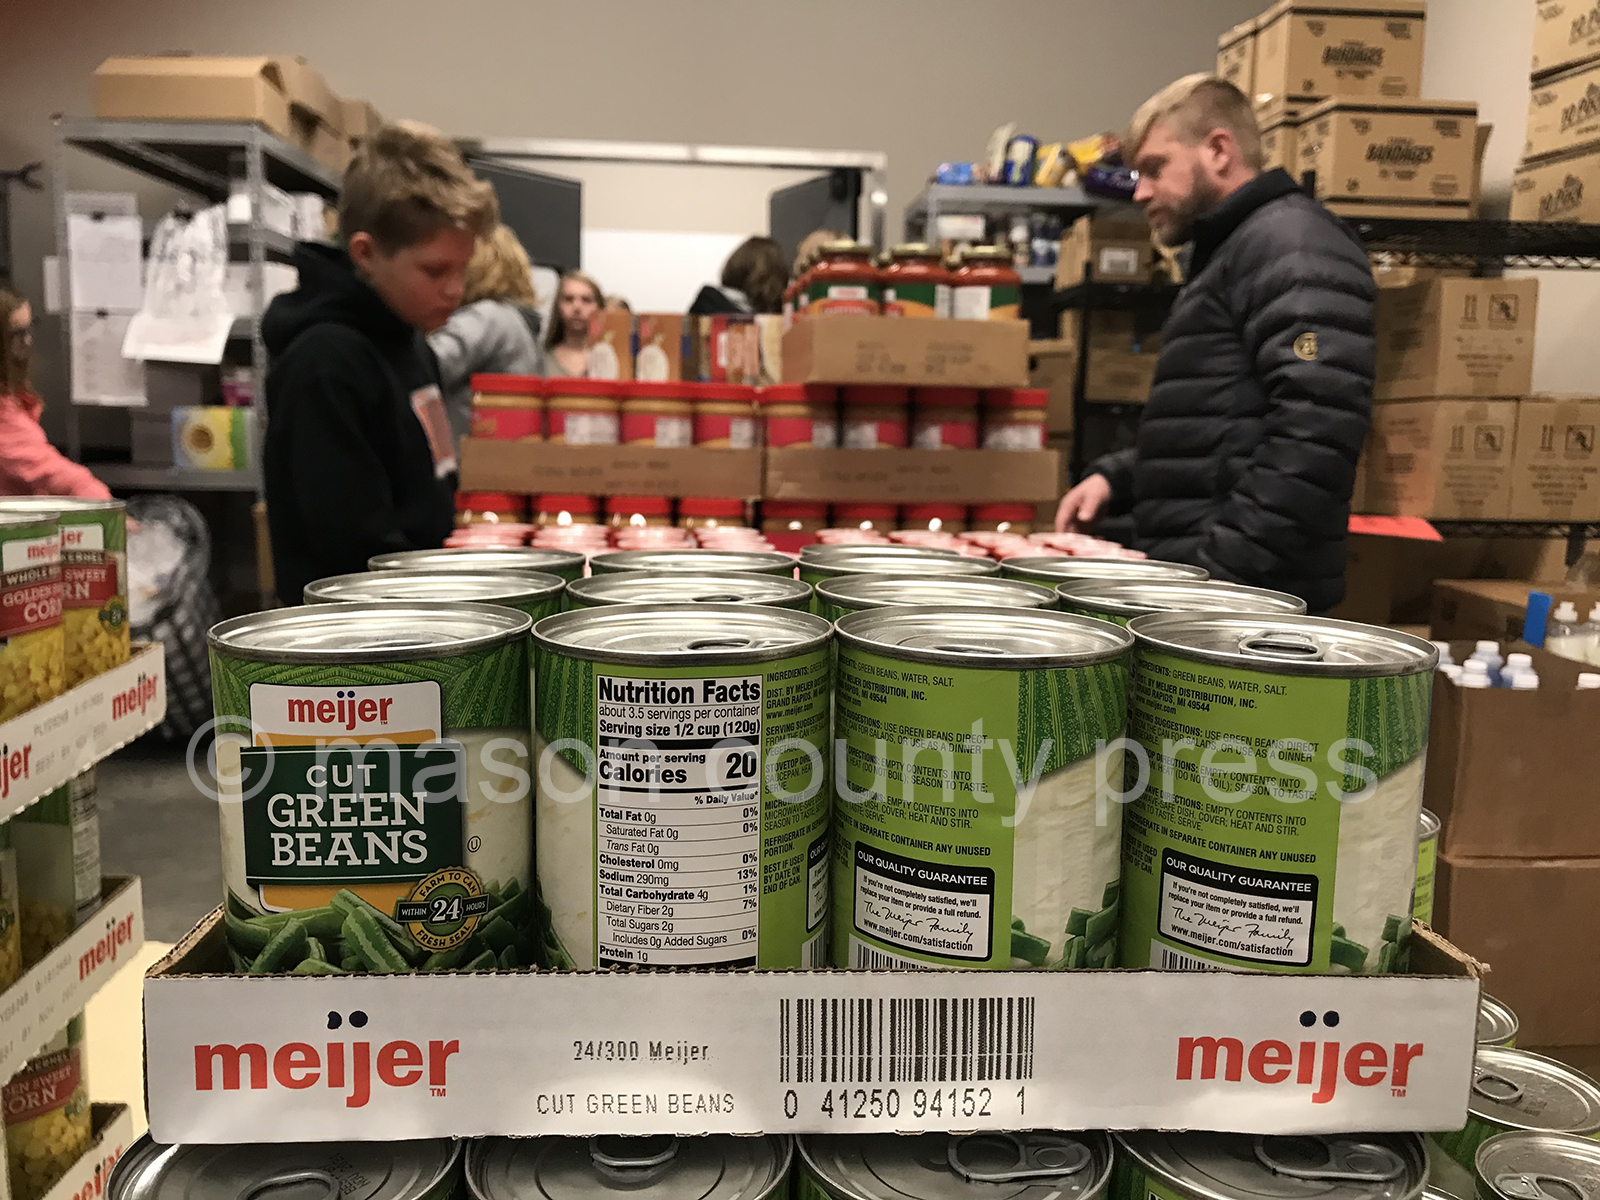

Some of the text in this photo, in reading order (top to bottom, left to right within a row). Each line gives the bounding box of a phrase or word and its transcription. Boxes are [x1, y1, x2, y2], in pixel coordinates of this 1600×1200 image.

[7, 567, 48, 585] WHOLE
[876, 667, 954, 687] BEANS, WATER, SALT.
[1173, 670, 1288, 696] GREEN BEANS, WATER, SALT.
[112, 672, 158, 720] meijer
[600, 678, 760, 704] Nutrition Facts
[863, 680, 927, 700] DISTRIBUTION, INC.
[1179, 687, 1257, 709] DISTRIBUTION, INC.
[288, 690, 392, 730] meijer
[599, 705, 760, 722] about 3.5 servings per container
[599, 719, 760, 737] Serving size 1/2 cup (120g)
[599, 750, 706, 764] Amount per serving
[599, 751, 756, 783] Calories 20
[0, 742, 32, 798] jer
[306, 764, 377, 788] CUT
[267, 791, 427, 827] GREEN
[695, 796, 703, 805] %
[706, 794, 729, 805] Daily
[599, 807, 758, 824] Total Fat 0g 0%
[606, 822, 758, 840] Saturated Fat 0g 0%
[860, 823, 991, 856] SEPARATE CONTAINER ANY UNUSED
[270, 830, 428, 866] BEANS
[606, 840, 659, 855] Trans Fat 0g
[1170, 827, 1316, 863] SEPARATE CONTAINER ANY UNUSED
[599, 852, 758, 872] Cholesterol 0mg 0%
[858, 850, 987, 885] OUR QUALITY GUARANTEE
[419, 872, 477, 897] FARM TO CAN
[599, 868, 757, 886] Sodium 290mg 13%
[1166, 857, 1312, 892] OUR QUALITY GUARANTEE
[599, 883, 757, 902] Total Carbohydrate 4g 1%
[860, 885, 877, 900] replace
[878, 892, 890, 903] your
[891, 896, 904, 908] item
[913, 902, 937, 915] provide
[944, 908, 955, 916] full
[957, 910, 981, 919] refund.
[868, 876, 883, 889] you're
[884, 882, 893, 892] not
[894, 885, 926, 902] completely
[928, 894, 958, 906] satisfied,
[960, 898, 976, 906] we'll
[1172, 881, 1299, 913] If you're not completely satisfied, we'll
[401, 908, 427, 916] WITHIN
[432, 898, 460, 921] 24
[466, 901, 486, 911] HOURS
[606, 898, 757, 917] Dietary Fiber 2g 7%
[1169, 892, 1189, 906] replace
[1190, 899, 1204, 909] your
[1206, 903, 1220, 913] item
[1231, 909, 1257, 921] provide
[1265, 914, 1276, 922] full
[1278, 916, 1303, 925] refund.
[416, 926, 470, 946] FRESH SEAL
[606, 916, 674, 932] Total Sugars 2g
[864, 918, 973, 951] www.meijer.com/satisfaction
[79, 912, 134, 981] meijer
[613, 929, 756, 948] Includes 0g Added Sugars 0%
[1172, 923, 1293, 956] www.meijer.com/satisfaction
[599, 945, 648, 961] Protein 1g
[194, 1010, 459, 1108] meijer
[573, 1040, 709, 1065] 24/300 Meijer
[1176, 1010, 1423, 1103] meijer
[537, 1094, 734, 1114] CUT GREEN BEANS
[784, 1086, 1025, 1119] 0 41250 94152 1
